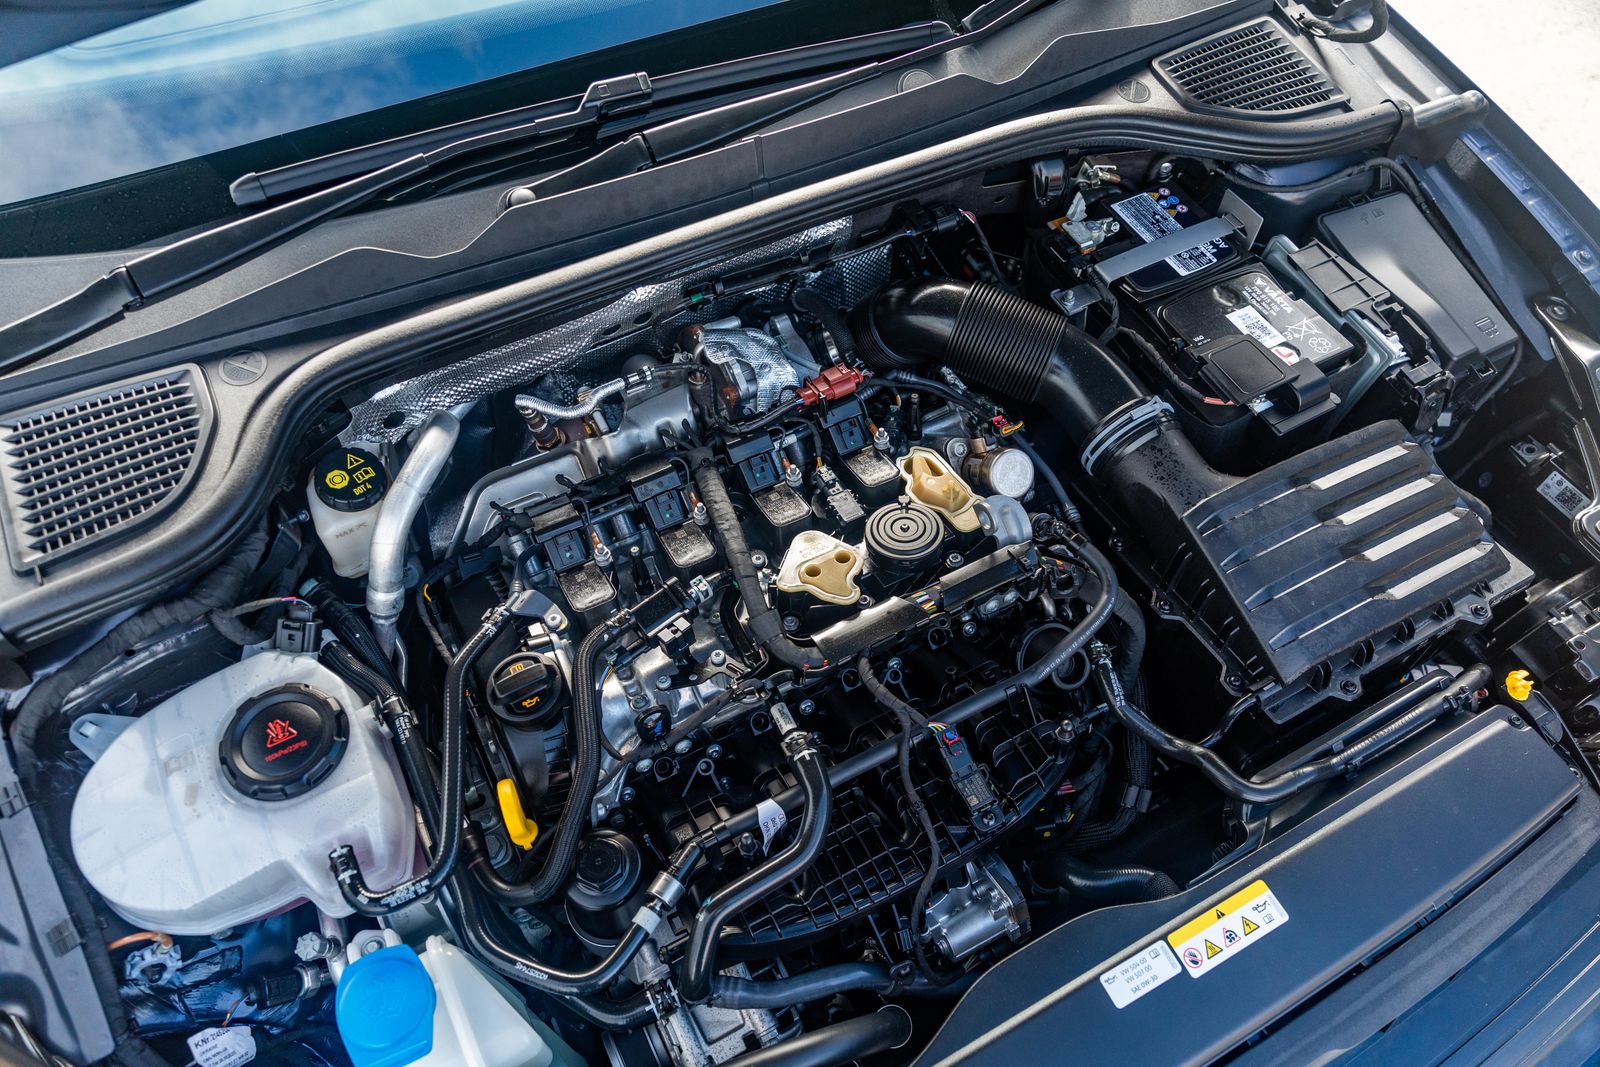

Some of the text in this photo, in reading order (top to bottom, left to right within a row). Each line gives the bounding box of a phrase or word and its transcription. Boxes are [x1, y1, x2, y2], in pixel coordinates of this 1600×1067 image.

[1264, 286, 1294, 314] VARTA
[353, 482, 373, 496] DOT 4
[1130, 974, 1159, 994] SAE 0W-30
